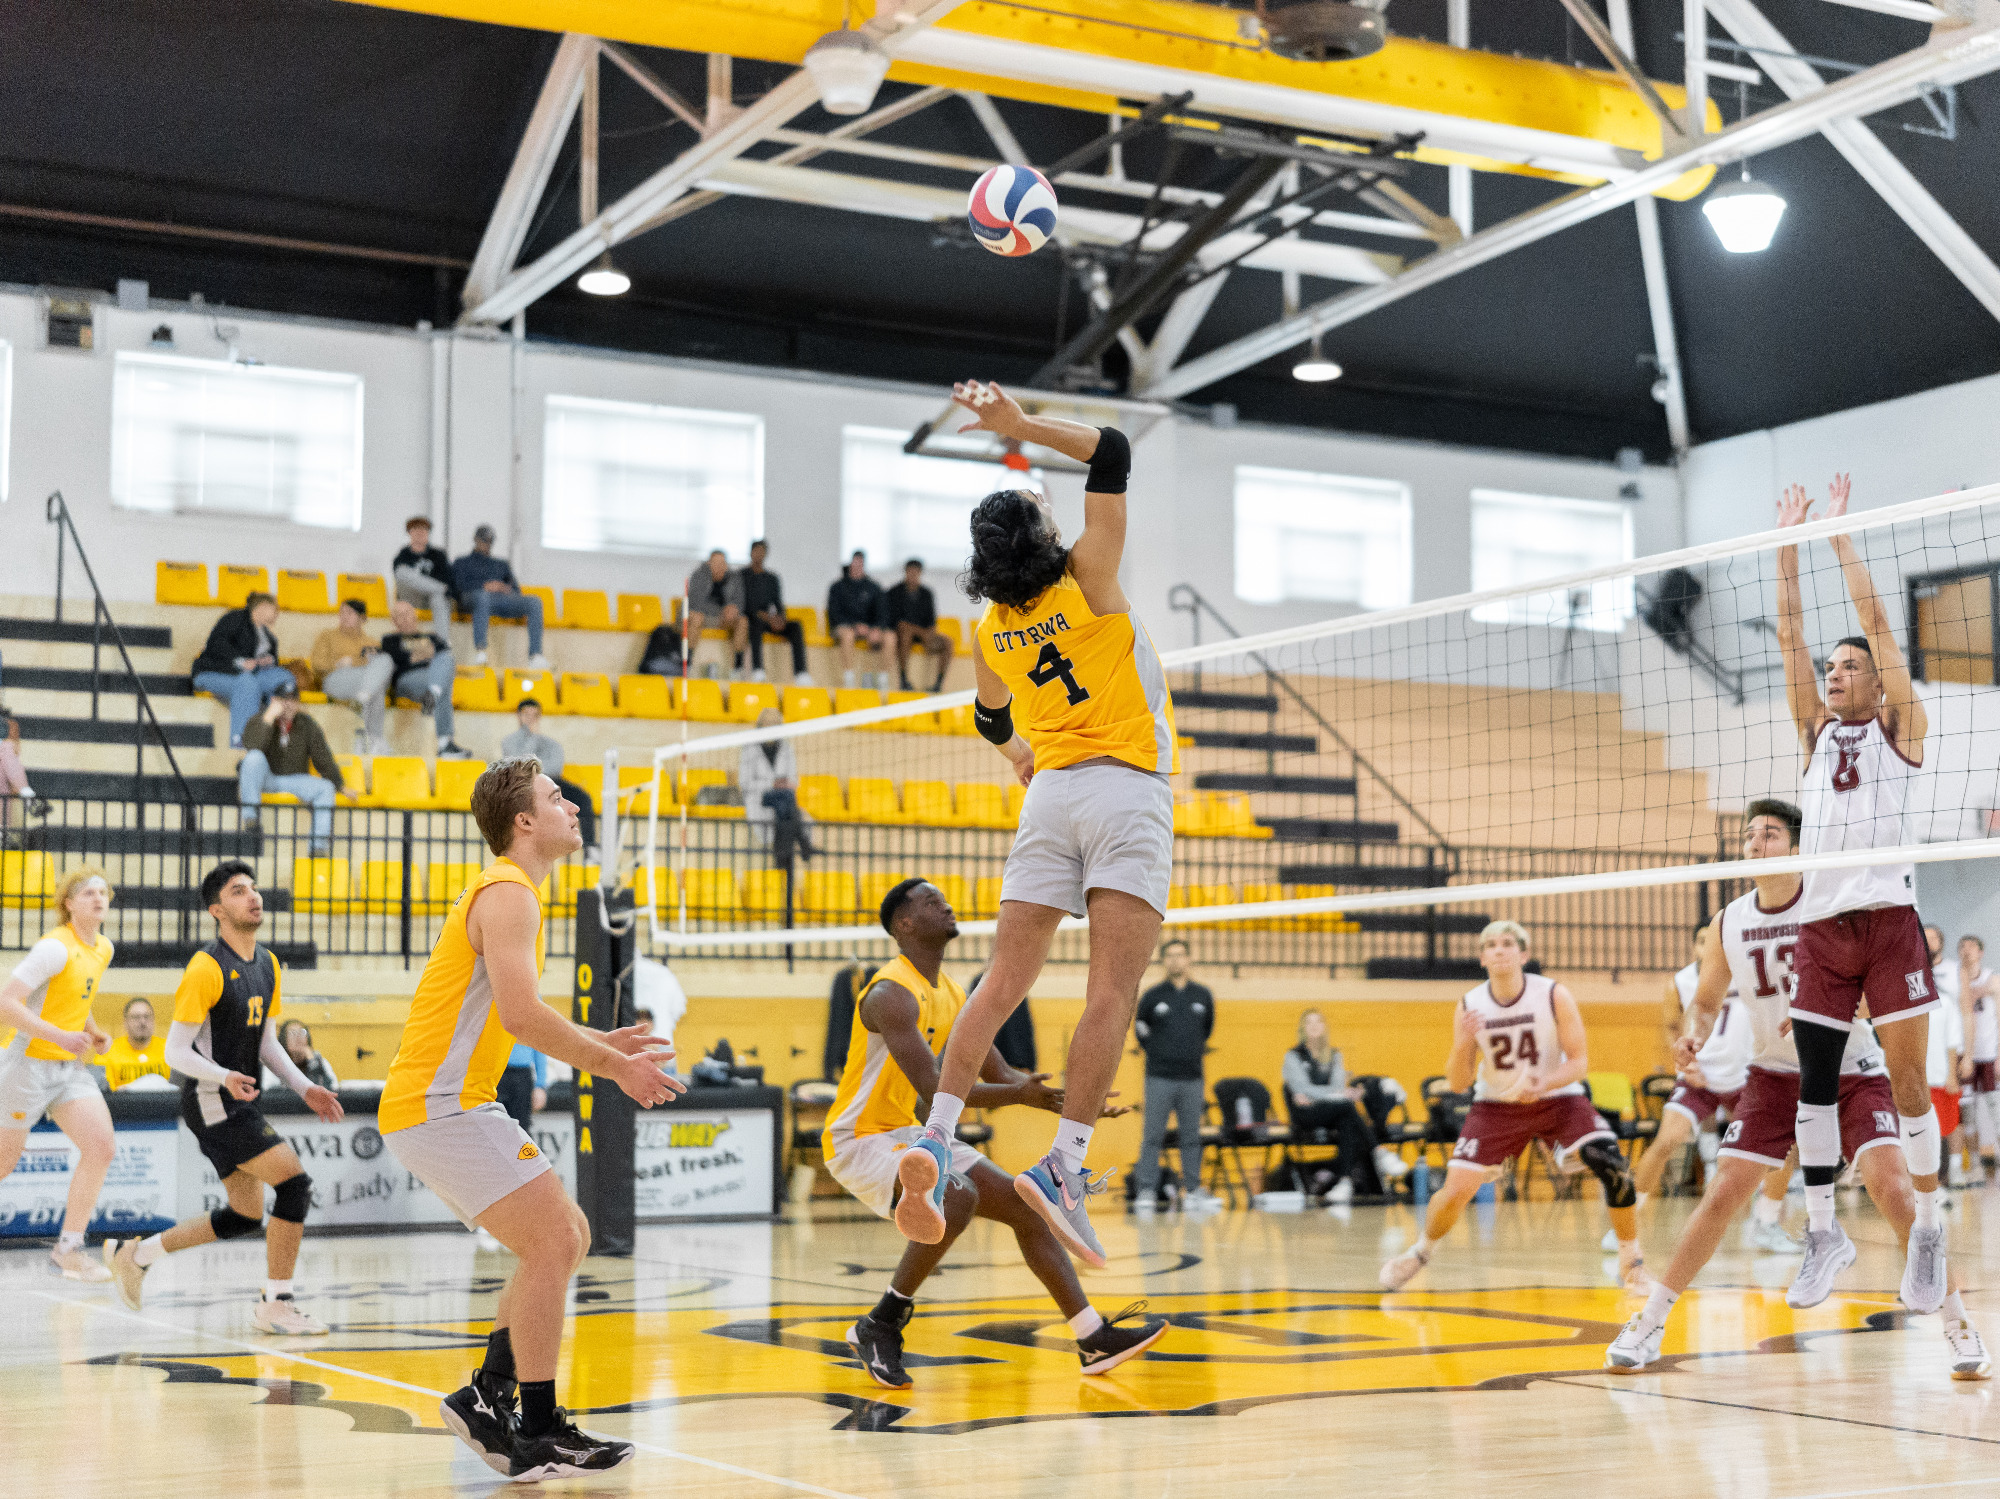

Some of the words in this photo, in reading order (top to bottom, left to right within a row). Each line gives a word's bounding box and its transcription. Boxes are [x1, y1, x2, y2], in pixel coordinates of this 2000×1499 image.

[993, 612, 1071, 653] OTTAWA
[1026, 641, 1091, 706] 4
[578, 963, 594, 1154] OTAWA
[1489, 1030, 1540, 1070] 24
